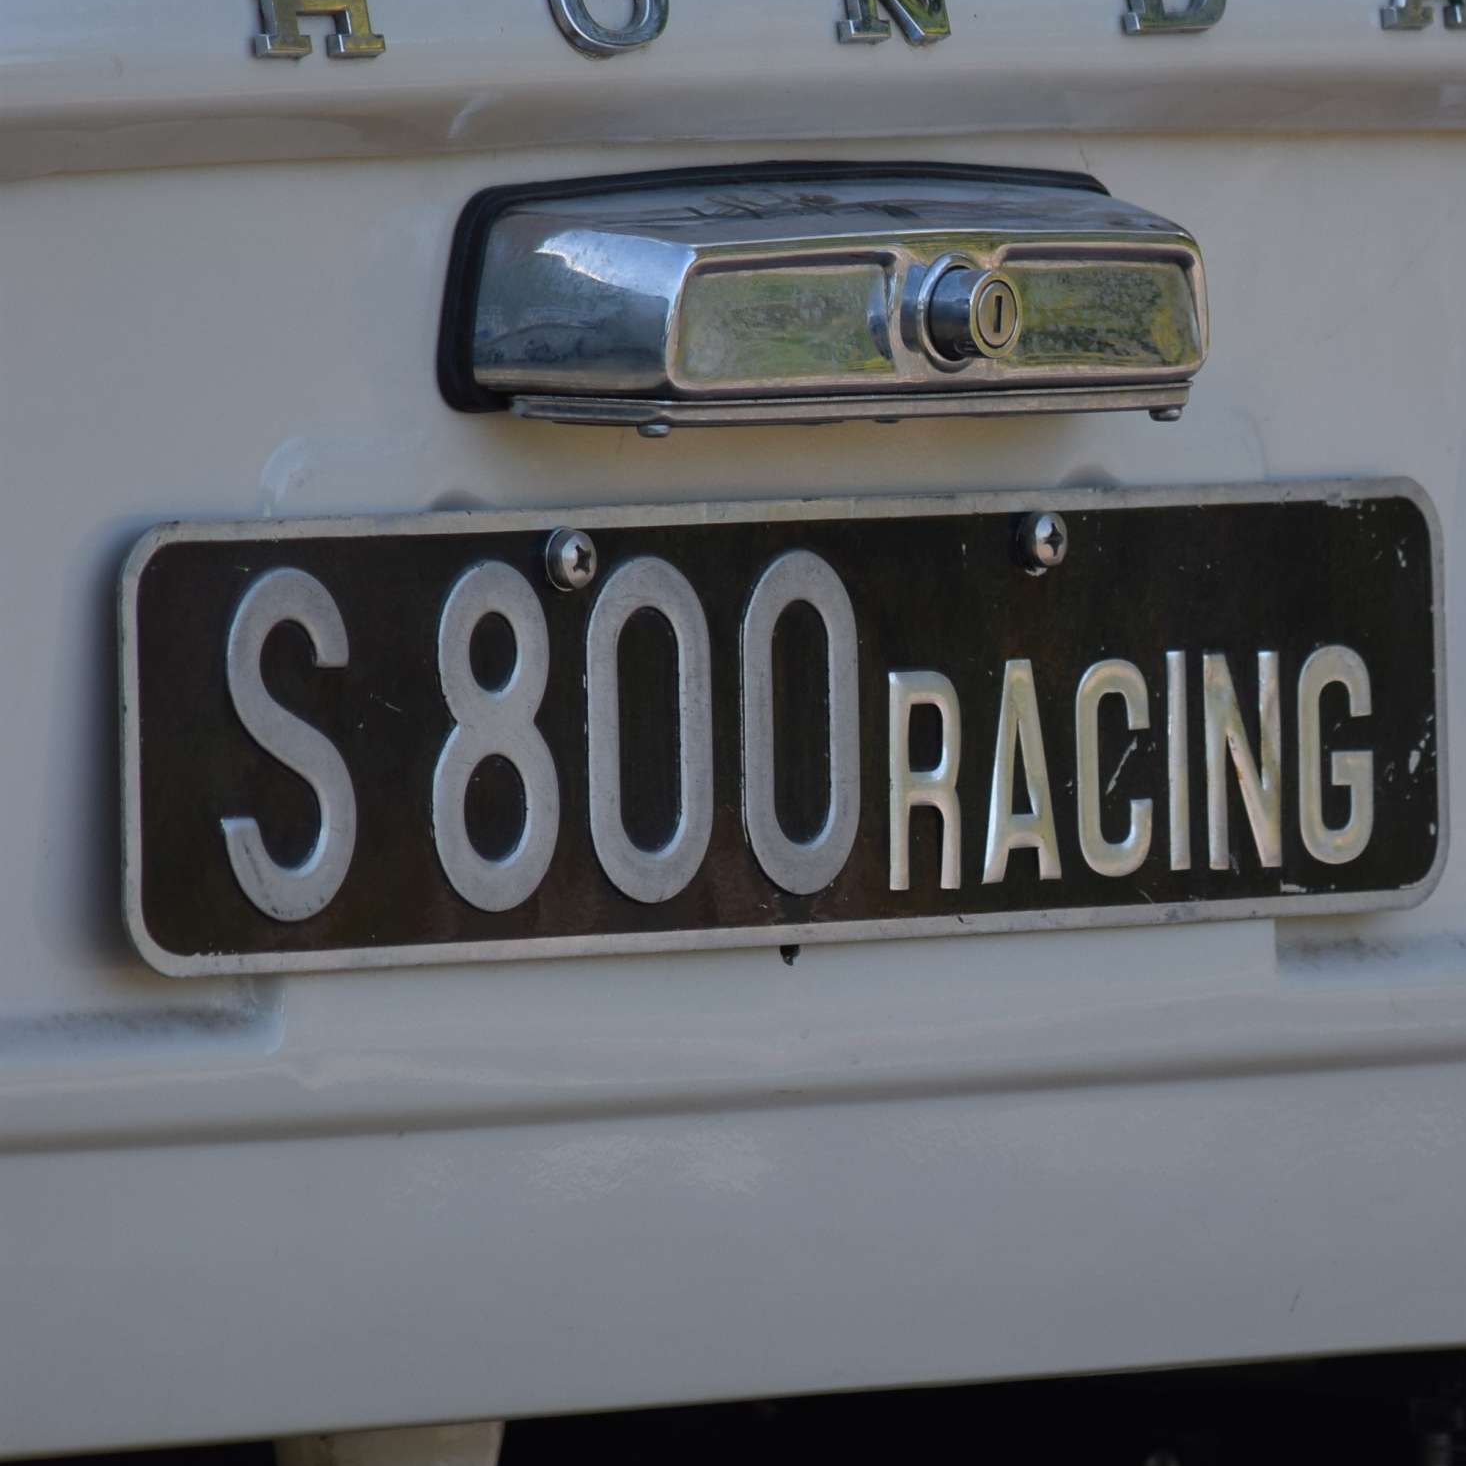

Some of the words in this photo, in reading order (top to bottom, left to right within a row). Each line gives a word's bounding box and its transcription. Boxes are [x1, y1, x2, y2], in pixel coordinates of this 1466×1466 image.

[221, 566, 357, 921] S
[431, 549, 861, 912] 800
[888, 644, 1375, 893] RACING
